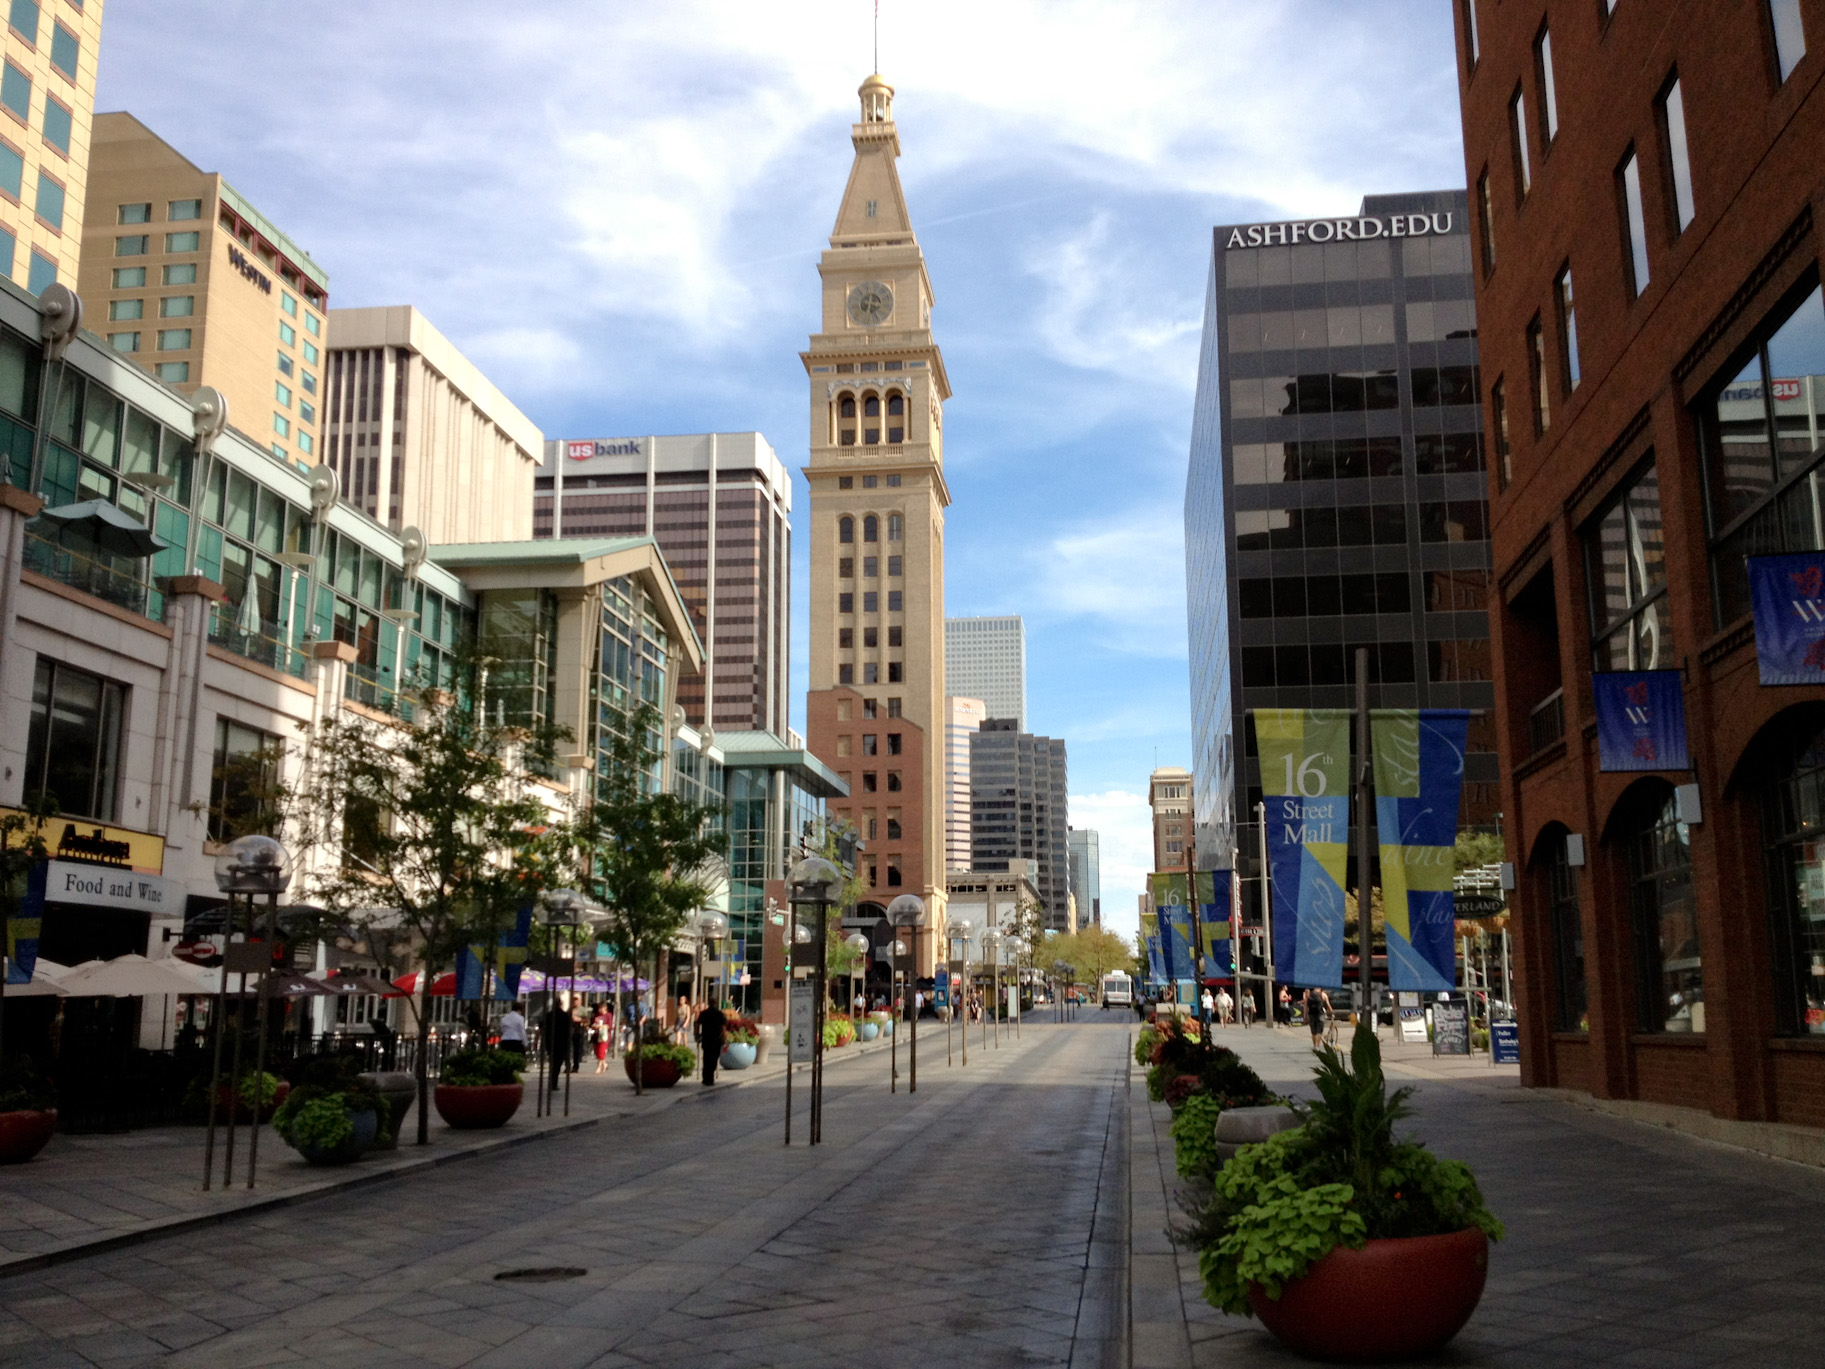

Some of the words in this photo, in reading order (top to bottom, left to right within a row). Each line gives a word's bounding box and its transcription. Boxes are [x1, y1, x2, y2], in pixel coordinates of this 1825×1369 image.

[1226, 212, 1453, 249] ASHFORD.EDU
[1283, 800, 1333, 820] Street
[1283, 823, 1332, 845] Mall
[65, 873, 103, 895] Food
[110, 882, 132, 898] and
[138, 883, 162, 903] Wine
